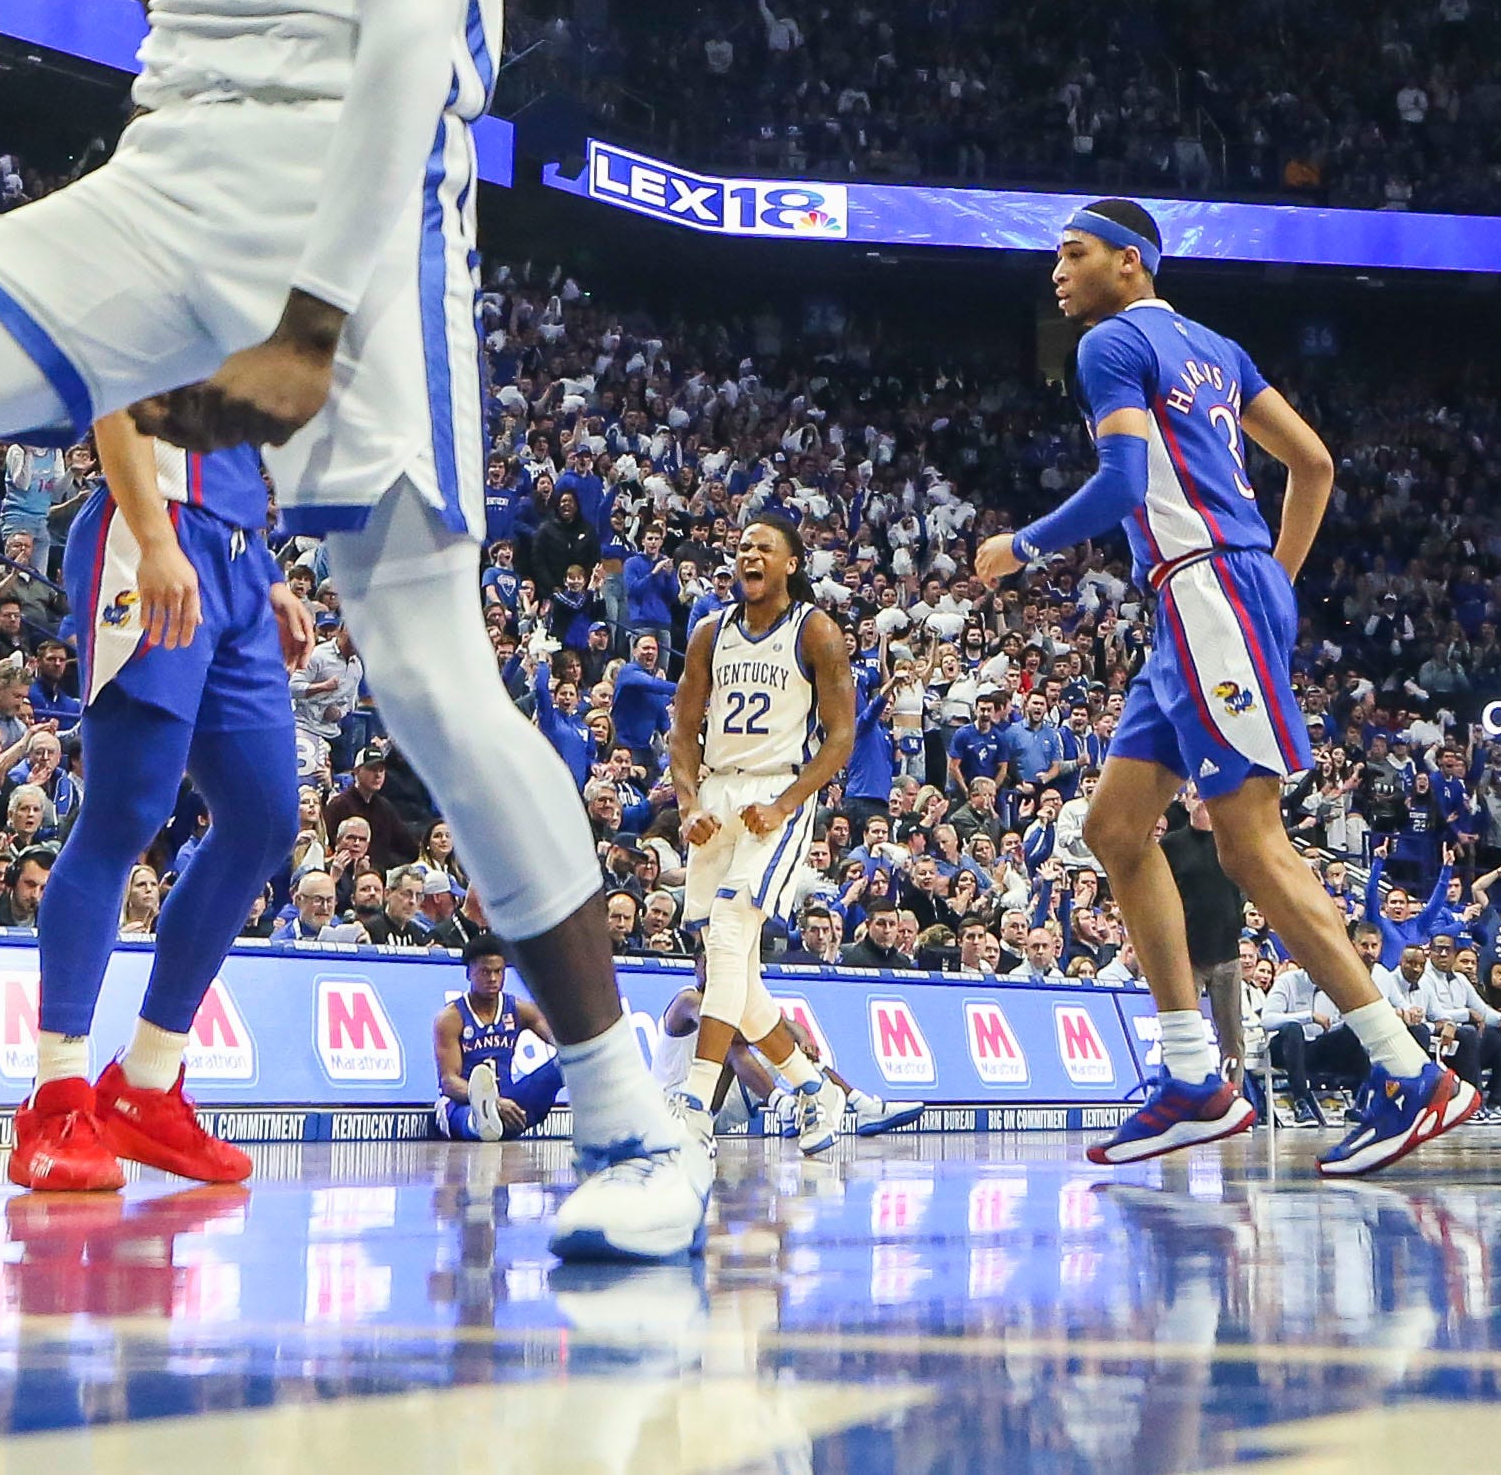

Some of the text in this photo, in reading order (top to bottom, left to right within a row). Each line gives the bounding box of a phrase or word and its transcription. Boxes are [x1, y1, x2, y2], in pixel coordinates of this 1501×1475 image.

[715, 662, 790, 691] KENTUCKY
[723, 691, 772, 735] 22
[327, 993, 387, 1050] M
[877, 1009, 923, 1057] M
[973, 1013, 1016, 1058] M
[1062, 1015, 1102, 1060] M
[331, 1053, 395, 1071] Marathon
[218, 1113, 307, 1141] COMMITMENT
[331, 1113, 396, 1141] KENTUCKY
[398, 1113, 429, 1139] FARM
[919, 1107, 1118, 1132] FARM BUREAU BIG ON COMMITMENT KENTUCKY
